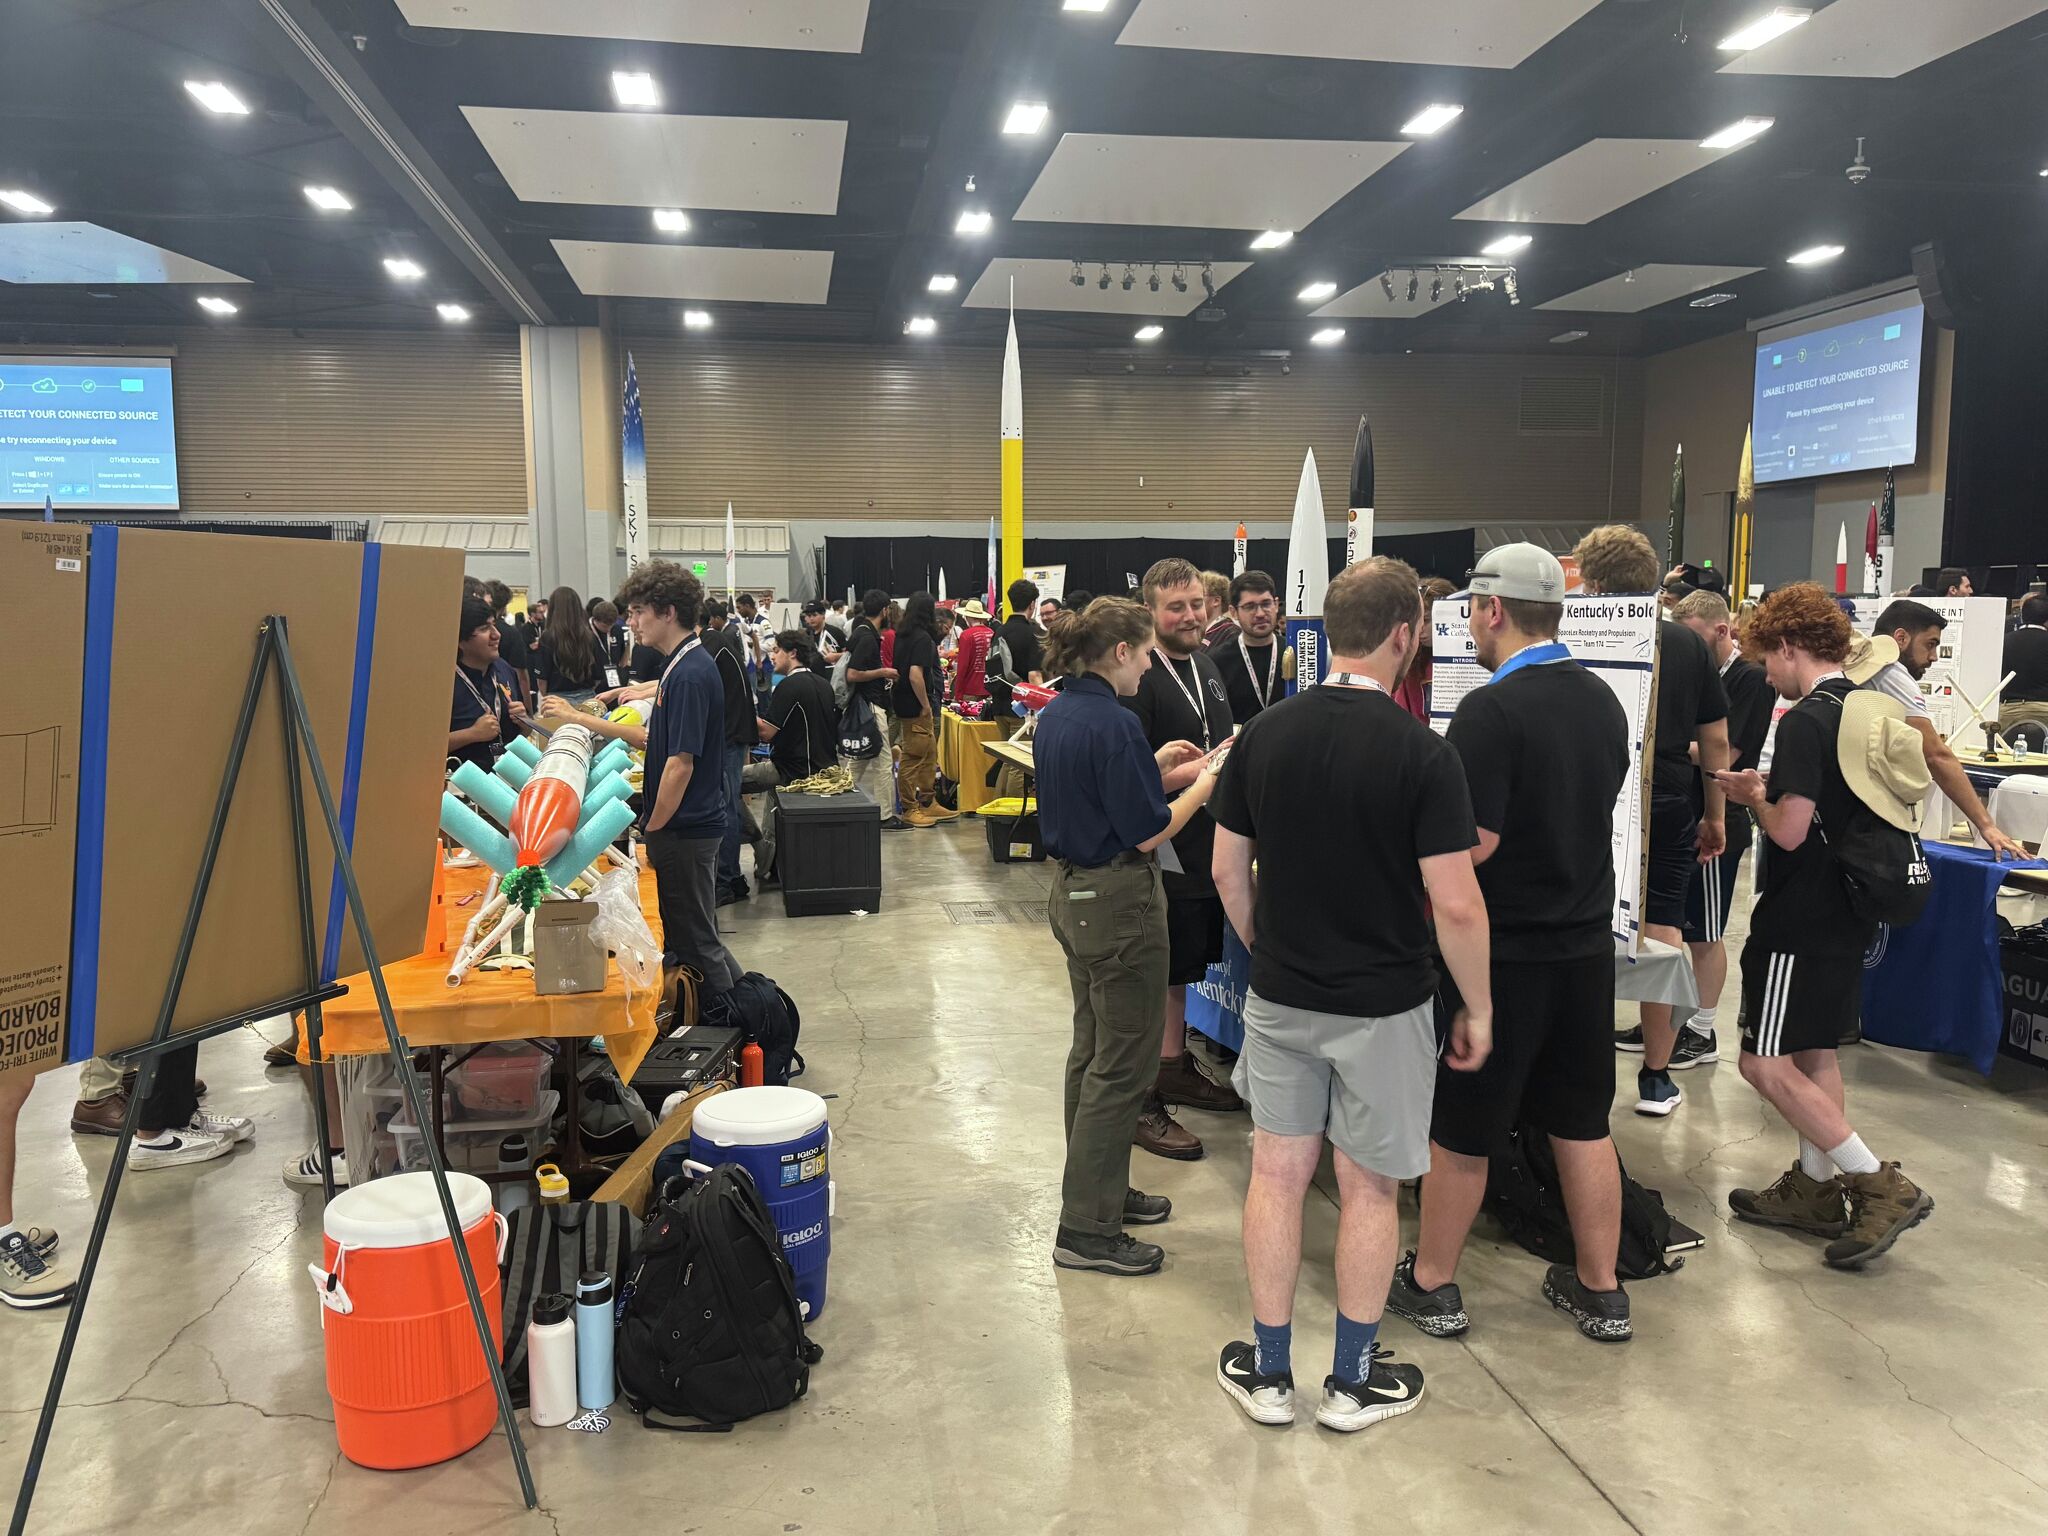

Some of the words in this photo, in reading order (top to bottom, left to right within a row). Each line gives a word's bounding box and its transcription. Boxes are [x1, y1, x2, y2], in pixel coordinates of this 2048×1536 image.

[1762, 385, 1785, 398] UNABLE
[1786, 382, 1794, 393] TO
[1794, 378, 1818, 392] DETECT
[1819, 374, 1837, 386] YOUR
[1837, 365, 1878, 382] CONNECTED
[1878, 359, 1909, 374] SOURCE
[28, 409, 57, 419] YOUR
[57, 409, 117, 420] CONNECTED
[118, 410, 159, 421] SOURCE
[1786, 409, 1802, 419] Please
[1803, 407, 1811, 417] try
[1810, 402, 1844, 415] reconnecting
[1844, 399, 1856, 410] your
[1857, 396, 1874, 407] device
[7, 437, 19, 446] try
[19, 435, 71, 446] reconnecting
[72, 437, 90, 446] your
[91, 436, 118, 446] device
[628, 504, 637, 543] SKY
[1295, 569, 1306, 615] 174
[1567, 603, 1624, 621] Kentucky's
[1948, 608, 1956, 617] IN
[1299, 631, 1306, 641] TO
[1435, 623, 1449, 636] UK
[1578, 628, 1598, 638] Rocketry
[1598, 629, 1608, 637] and
[1608, 629, 1636, 638] Propulsion
[1307, 631, 1316, 656] KELLY
[1583, 640, 1595, 648] Team
[1596, 640, 1604, 648] 174
[1299, 641, 1307, 667] THANKS
[1307, 657, 1315, 680] CLINT
[1299, 668, 1307, 692] PECIAL
[35, 975, 56, 986] Sturdy
[0, 996, 61, 1032] BOARD
[29, 1046, 57, 1063] WHITE
[797, 1147, 819, 1159] IGLOO
[782, 1222, 822, 1245] IGLOO
